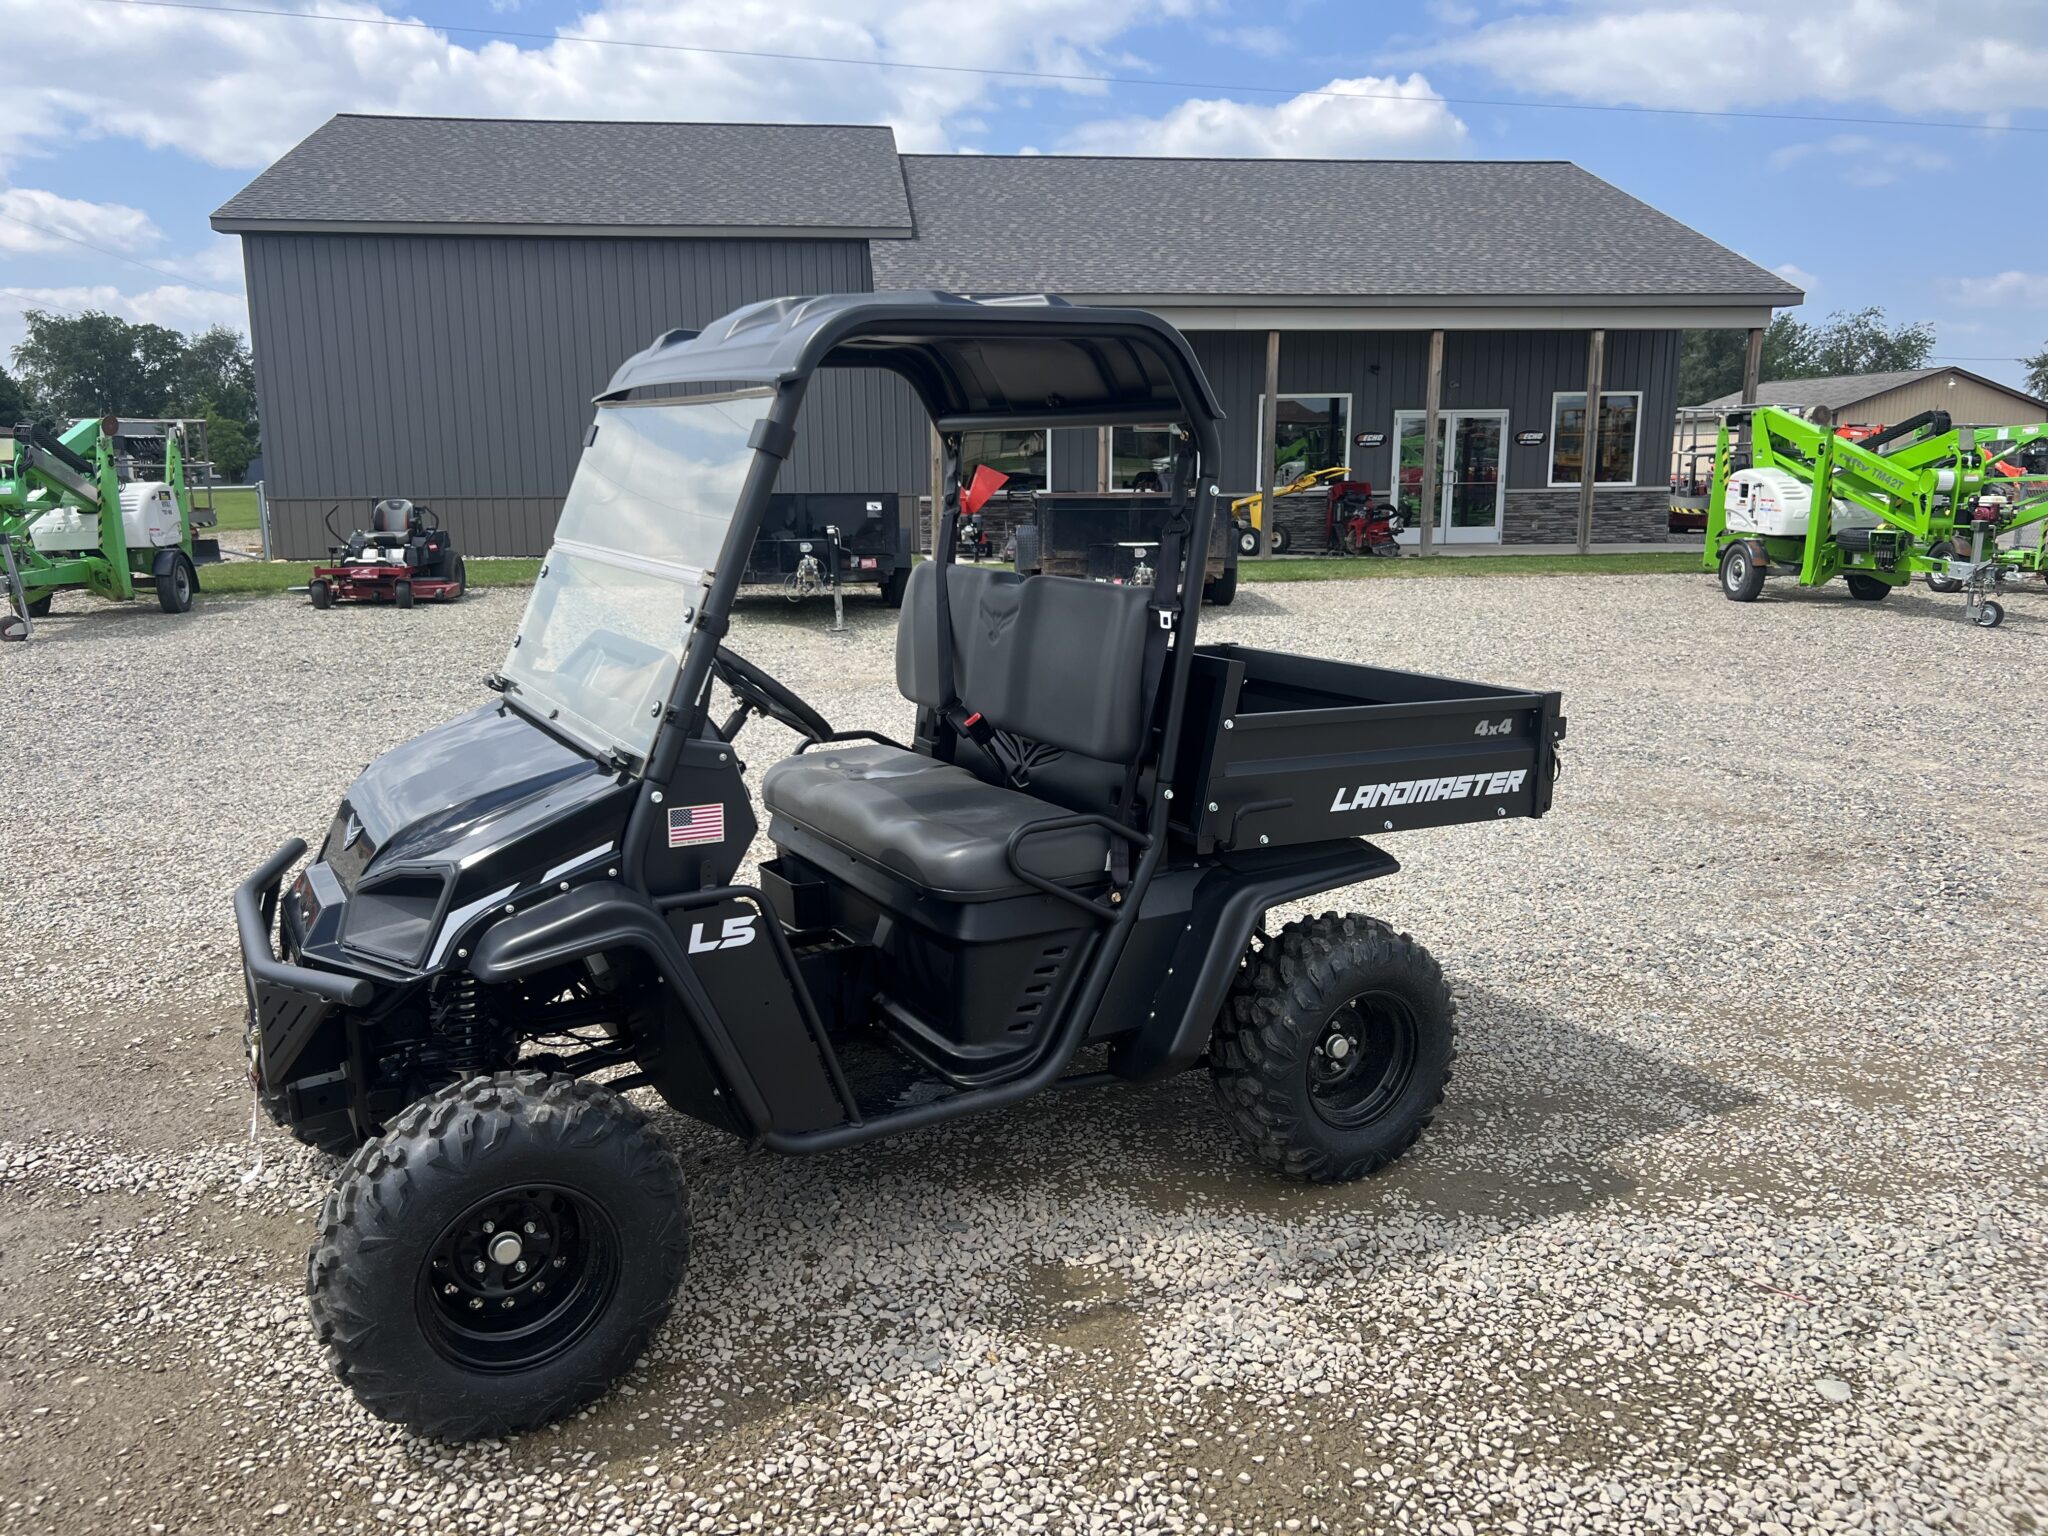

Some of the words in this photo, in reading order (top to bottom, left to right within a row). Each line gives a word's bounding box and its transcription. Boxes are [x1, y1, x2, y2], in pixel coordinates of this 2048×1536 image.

[1872, 467, 1905, 490] TM42T
[1474, 717, 1513, 737] 4x4
[1330, 769, 1528, 813] LANDMASTER
[688, 914, 757, 954] L5
